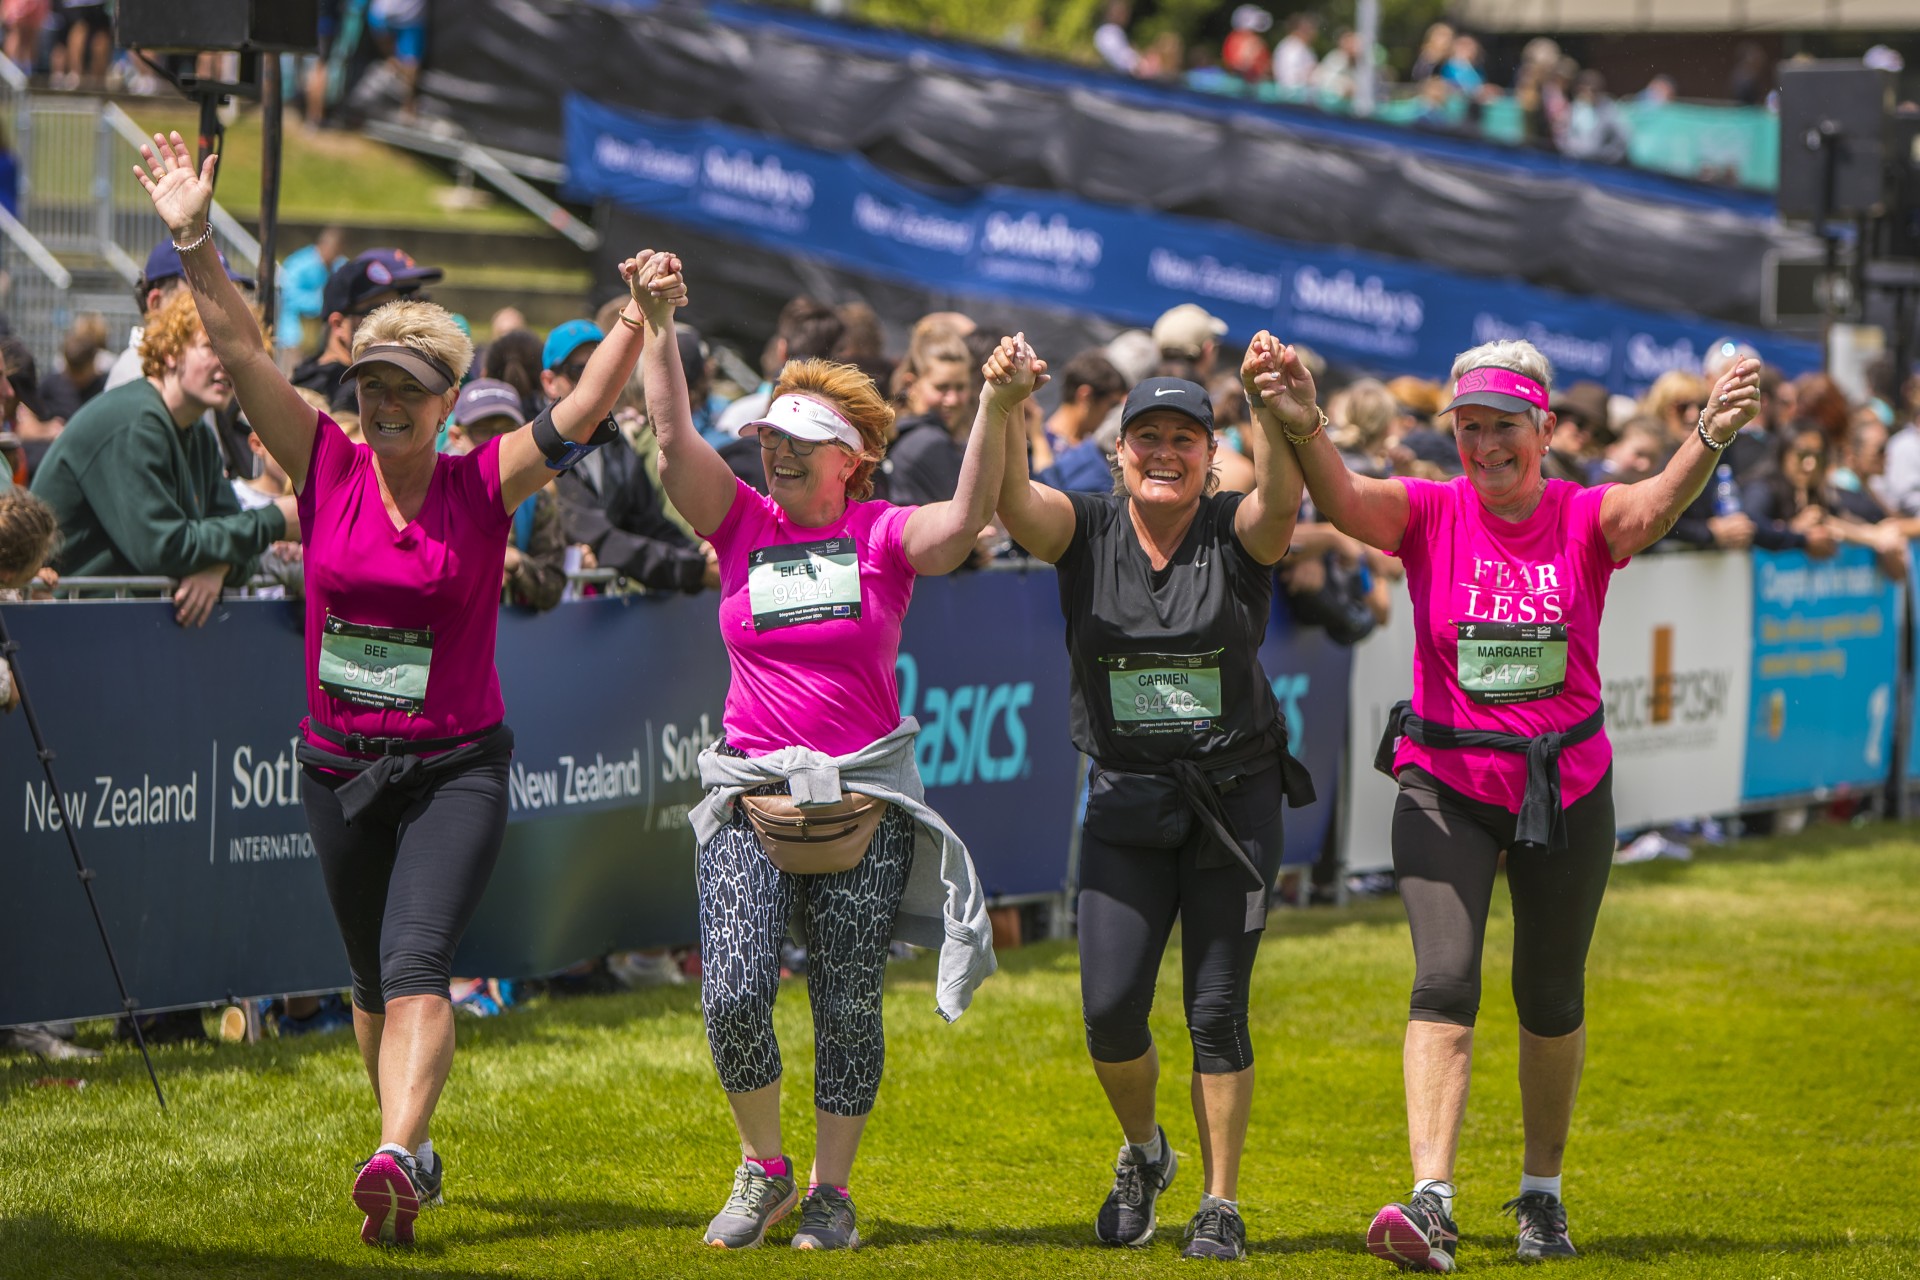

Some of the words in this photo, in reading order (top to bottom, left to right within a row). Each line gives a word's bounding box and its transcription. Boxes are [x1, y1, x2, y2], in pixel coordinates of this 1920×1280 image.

[780, 562, 822, 578] EILEEN
[1472, 556, 1561, 591] FEAR
[772, 577, 833, 606] 9424
[1464, 589, 1563, 623] LESS
[364, 643, 388, 659] BEE
[1477, 646, 1544, 658] MARGARET
[344, 659, 398, 688] 9191
[1138, 673, 1189, 687] CARMEN
[1481, 664, 1540, 686] 9475
[1134, 691, 1195, 715] 9446
[509, 761, 558, 811] New
[558, 747, 642, 805] Zealand
[24, 781, 87, 833] New
[94, 770, 198, 828] Zealand
